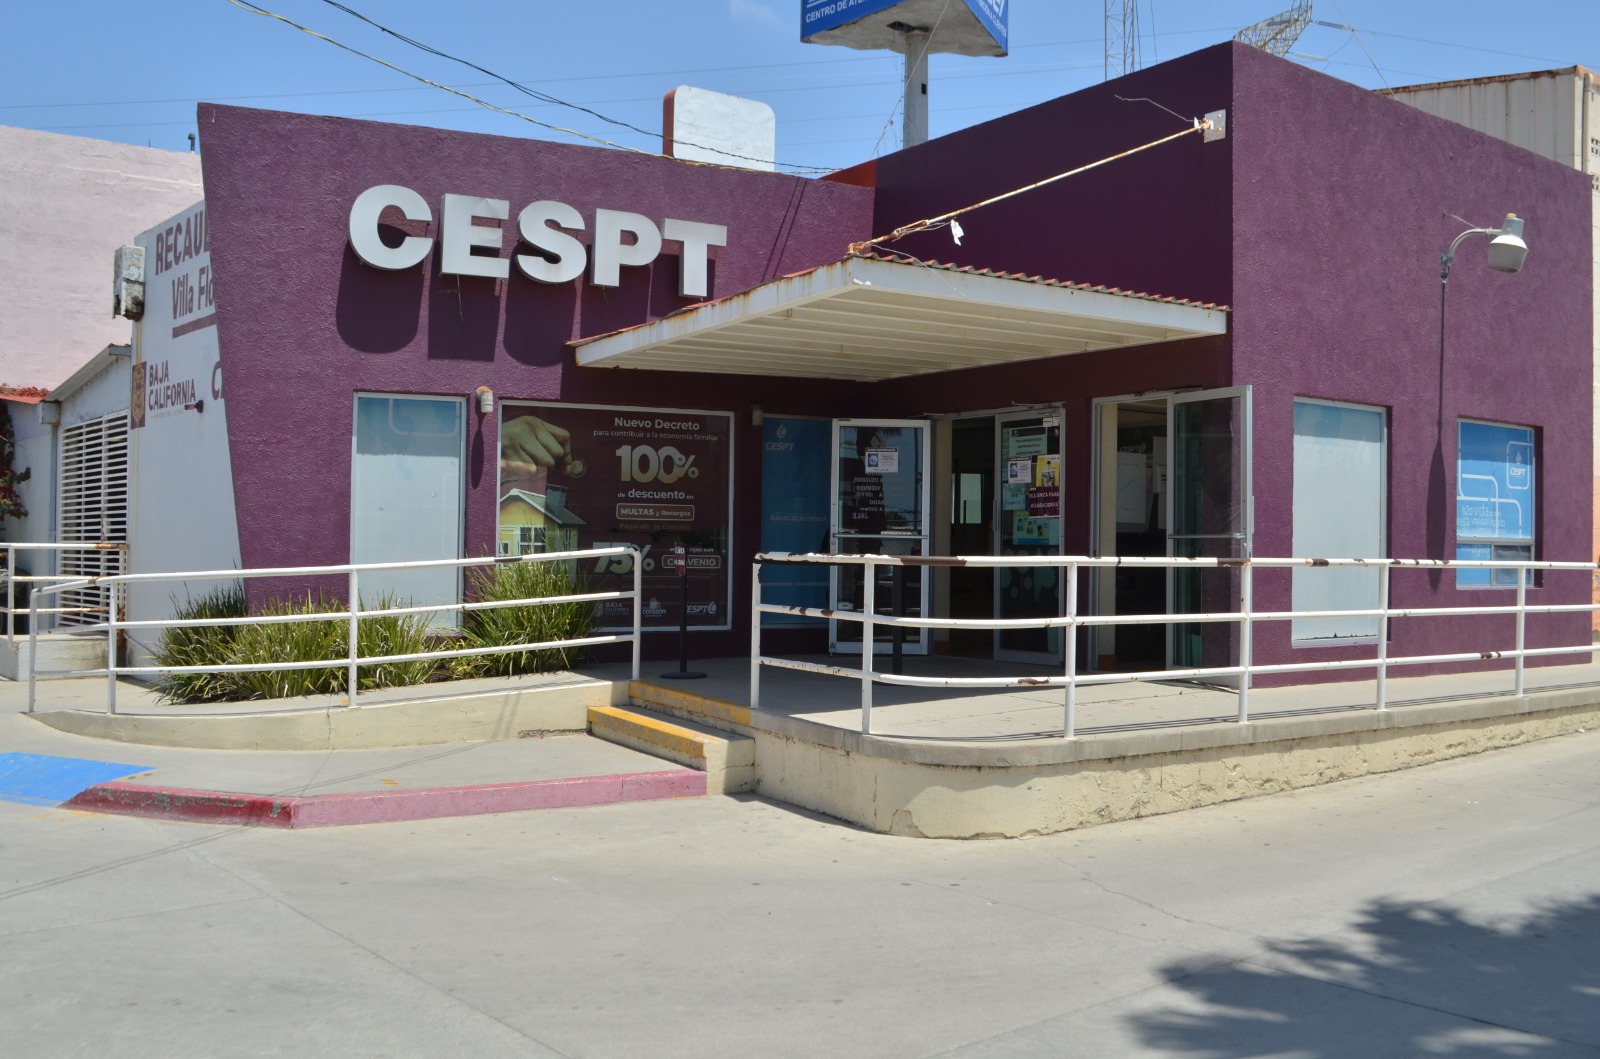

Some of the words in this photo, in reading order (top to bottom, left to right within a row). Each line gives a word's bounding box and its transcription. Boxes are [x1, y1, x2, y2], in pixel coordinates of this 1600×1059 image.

[805, 4, 836, 23] CENTRO
[837, 1, 848, 12] DE
[348, 183, 728, 299] CESPT
[172, 273, 194, 320] Villa
[149, 360, 169, 387] BAJA
[149, 378, 197, 411] CALIFORNIA
[614, 417, 652, 428] Nuevo
[655, 419, 700, 430] Decreto
[593, 430, 609, 438] para
[611, 430, 644, 438] contribuir
[694, 433, 718, 441] familiar
[765, 441, 795, 452] CESPT
[615, 444, 699, 484] 100%
[627, 489, 686, 500] descuento
[620, 507, 654, 516] MULTAS
[661, 510, 691, 518] Recargos
[1473, 503, 1489, 517] vida
[667, 557, 716, 567] CVENIO
[686, 605, 708, 613] ESPT
